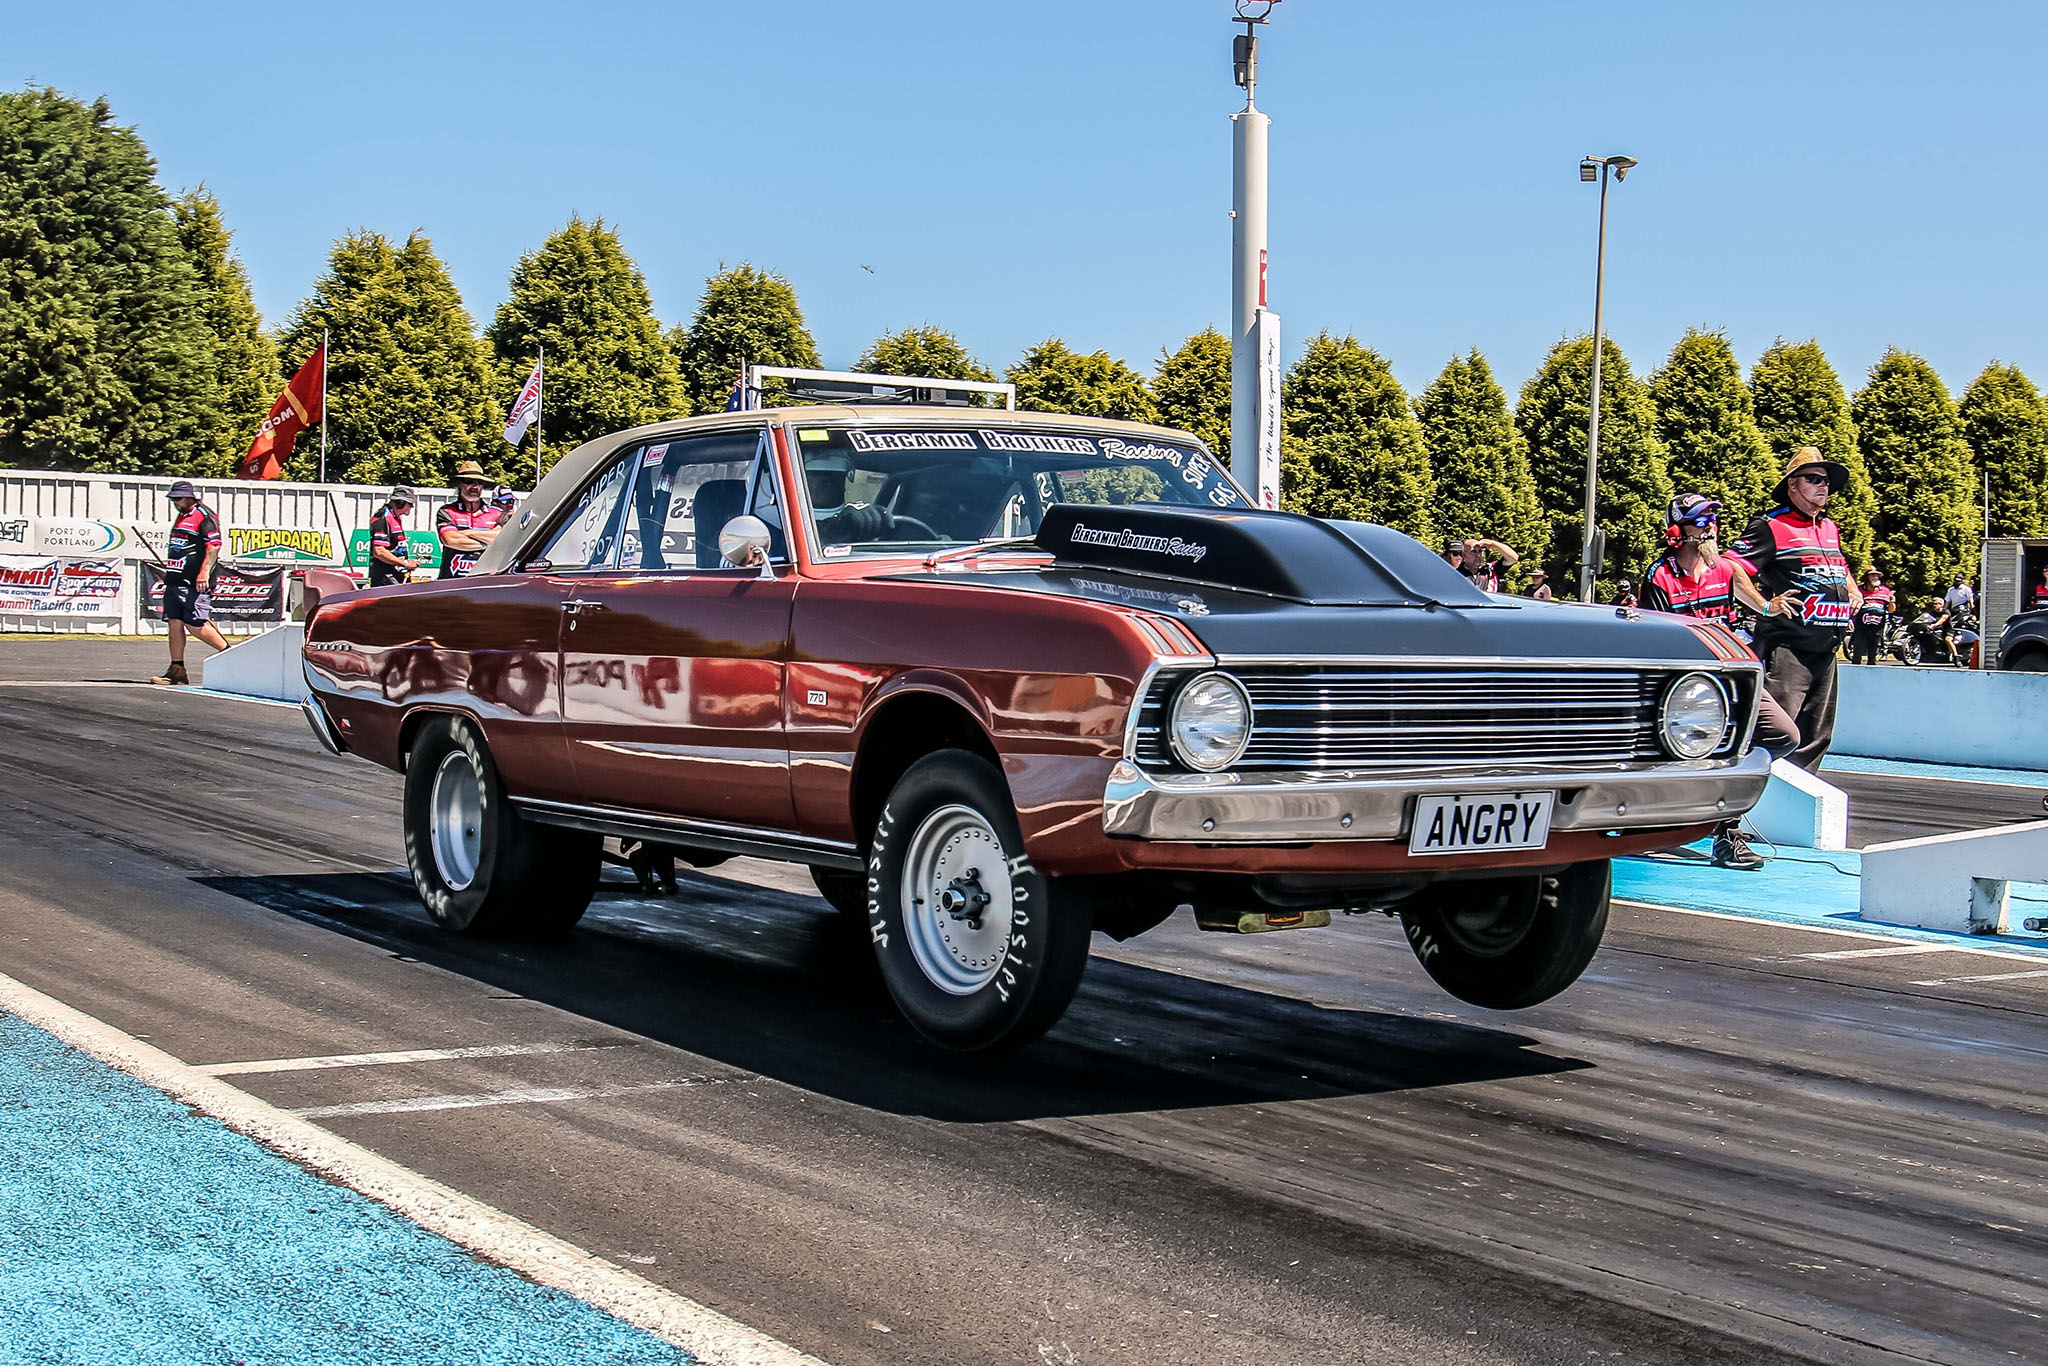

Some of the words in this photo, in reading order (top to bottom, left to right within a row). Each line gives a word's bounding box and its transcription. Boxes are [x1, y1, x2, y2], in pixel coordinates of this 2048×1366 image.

[846, 430, 978, 453] BERGAMIN
[977, 429, 1098, 456] BROTHERS
[1098, 438, 1184, 468] Racing
[577, 460, 626, 510] SUPER
[1182, 452, 1213, 490] SUPER
[1208, 481, 1238, 508] GAS
[43, 537, 96, 547] PORTLAND
[49, 527, 74, 536] PORT
[78, 528, 92, 536] OF
[140, 531, 164, 539] PORT
[229, 528, 333, 560] TYRENDARRA
[1070, 523, 1121, 548] BERGAMIN
[1118, 529, 1169, 553] BROTHERS
[1164, 537, 1207, 563] Racing
[264, 550, 296, 559] LIME
[411, 543, 434, 554] 766
[809, 693, 825, 703] 770
[1424, 802, 1542, 848] ANGRY
[995, 853, 1038, 1003] Hoosier
